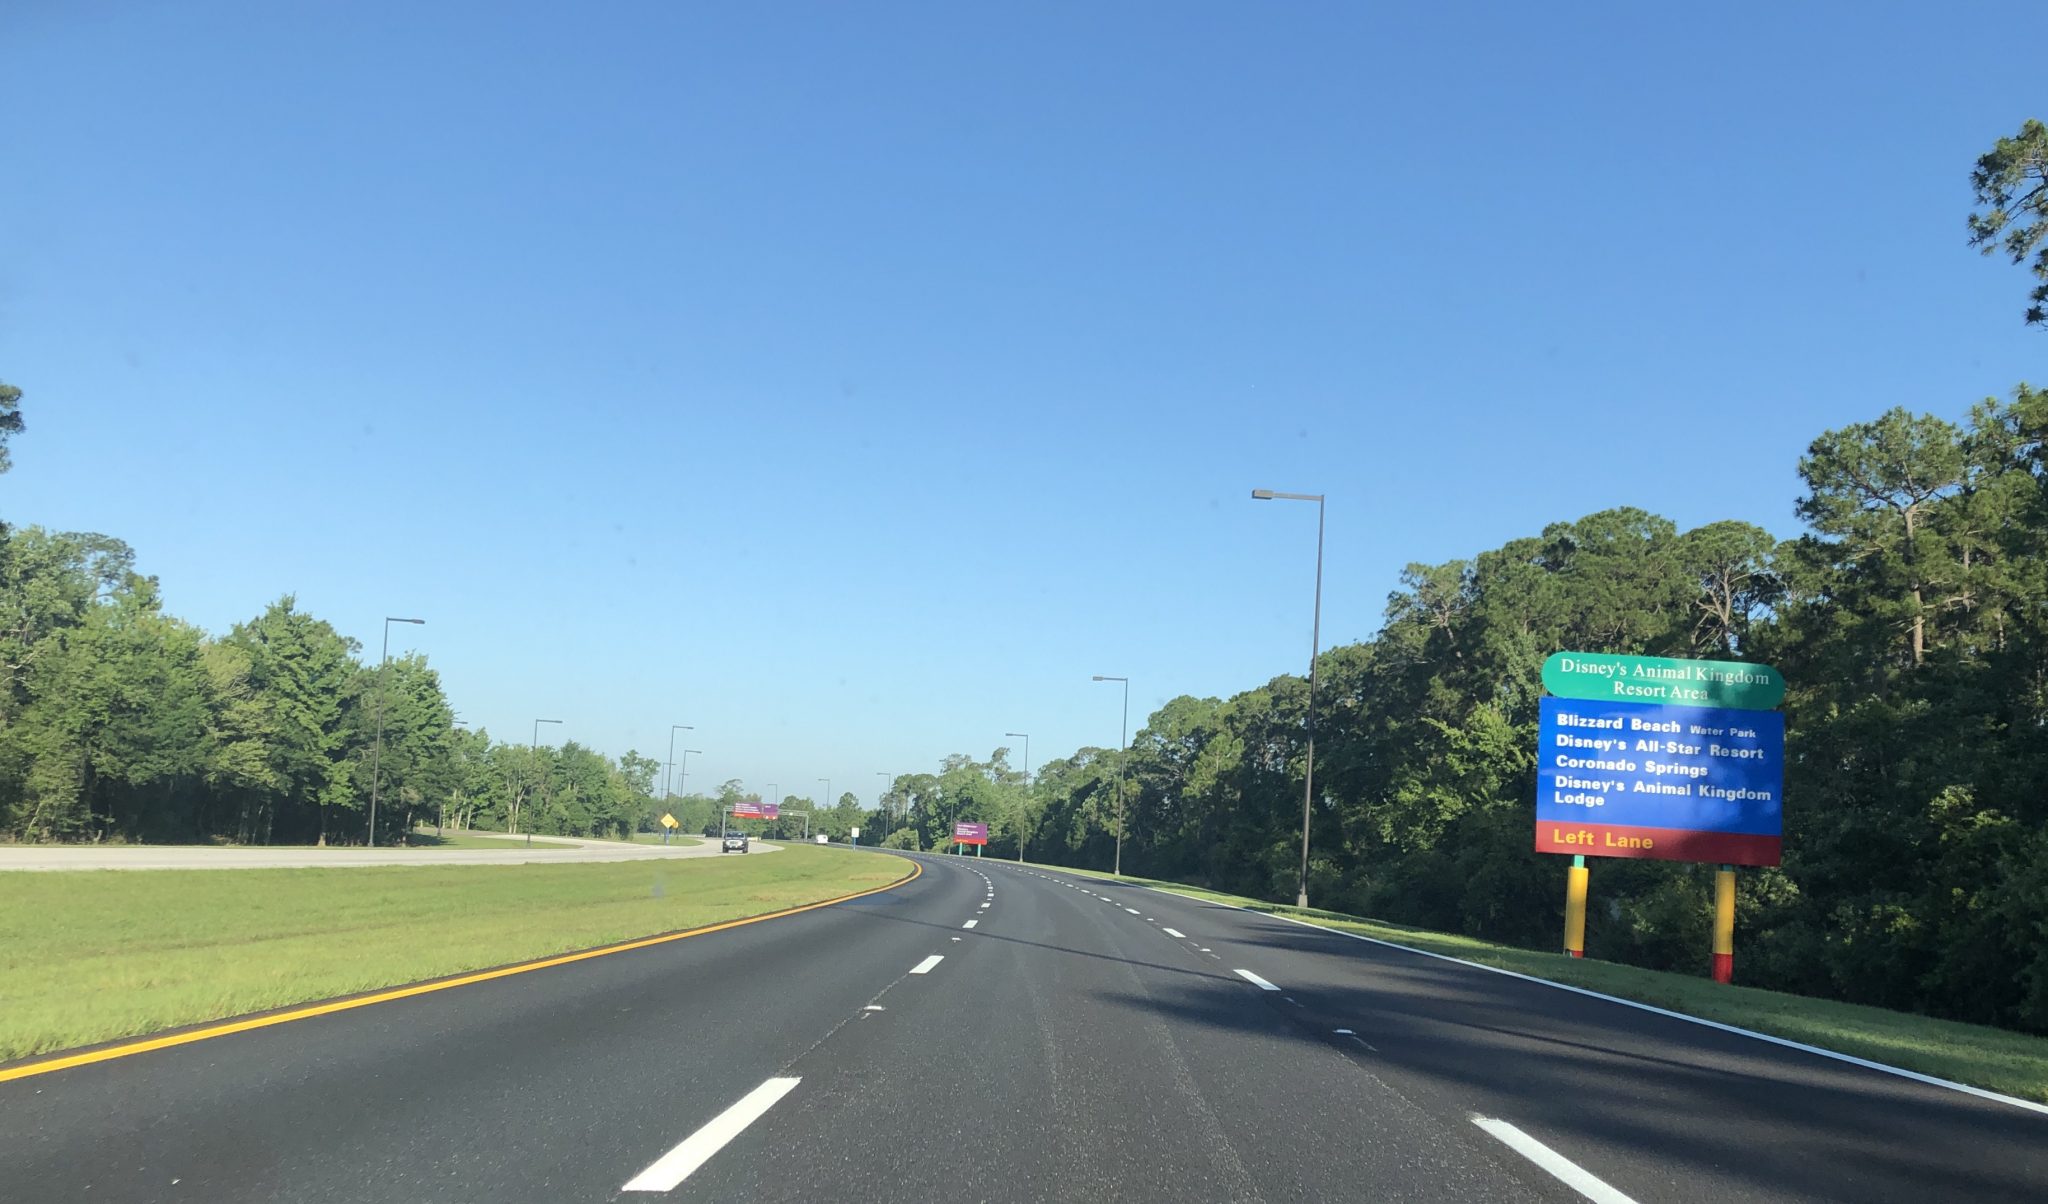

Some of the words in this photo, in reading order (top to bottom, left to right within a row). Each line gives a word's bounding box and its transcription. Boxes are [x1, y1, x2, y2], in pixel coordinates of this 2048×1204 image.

[1561, 659, 1627, 678] Disney's
[1633, 664, 1691, 680] Animal
[1696, 668, 1769, 686] Kingdom
[1614, 681, 1665, 697] Resort
[1670, 686, 1708, 700] Area
[1557, 714, 1623, 729] Blizzard
[1631, 718, 1681, 733] Beach
[1690, 725, 1724, 736] Water
[1730, 728, 1756, 738] Park
[1556, 734, 1627, 751] Disney's
[1635, 740, 1701, 755] All-Star
[1710, 745, 1764, 759] Resort
[1556, 755, 1636, 772] Coronado
[1645, 761, 1708, 778] Springs
[1555, 776, 1624, 793] Disney's
[1633, 781, 1691, 796] Animal
[1699, 785, 1771, 801] Kingdom
[1555, 791, 1605, 807] Lodge
[1554, 829, 1594, 845] Left
[1606, 832, 1653, 849] Lane
